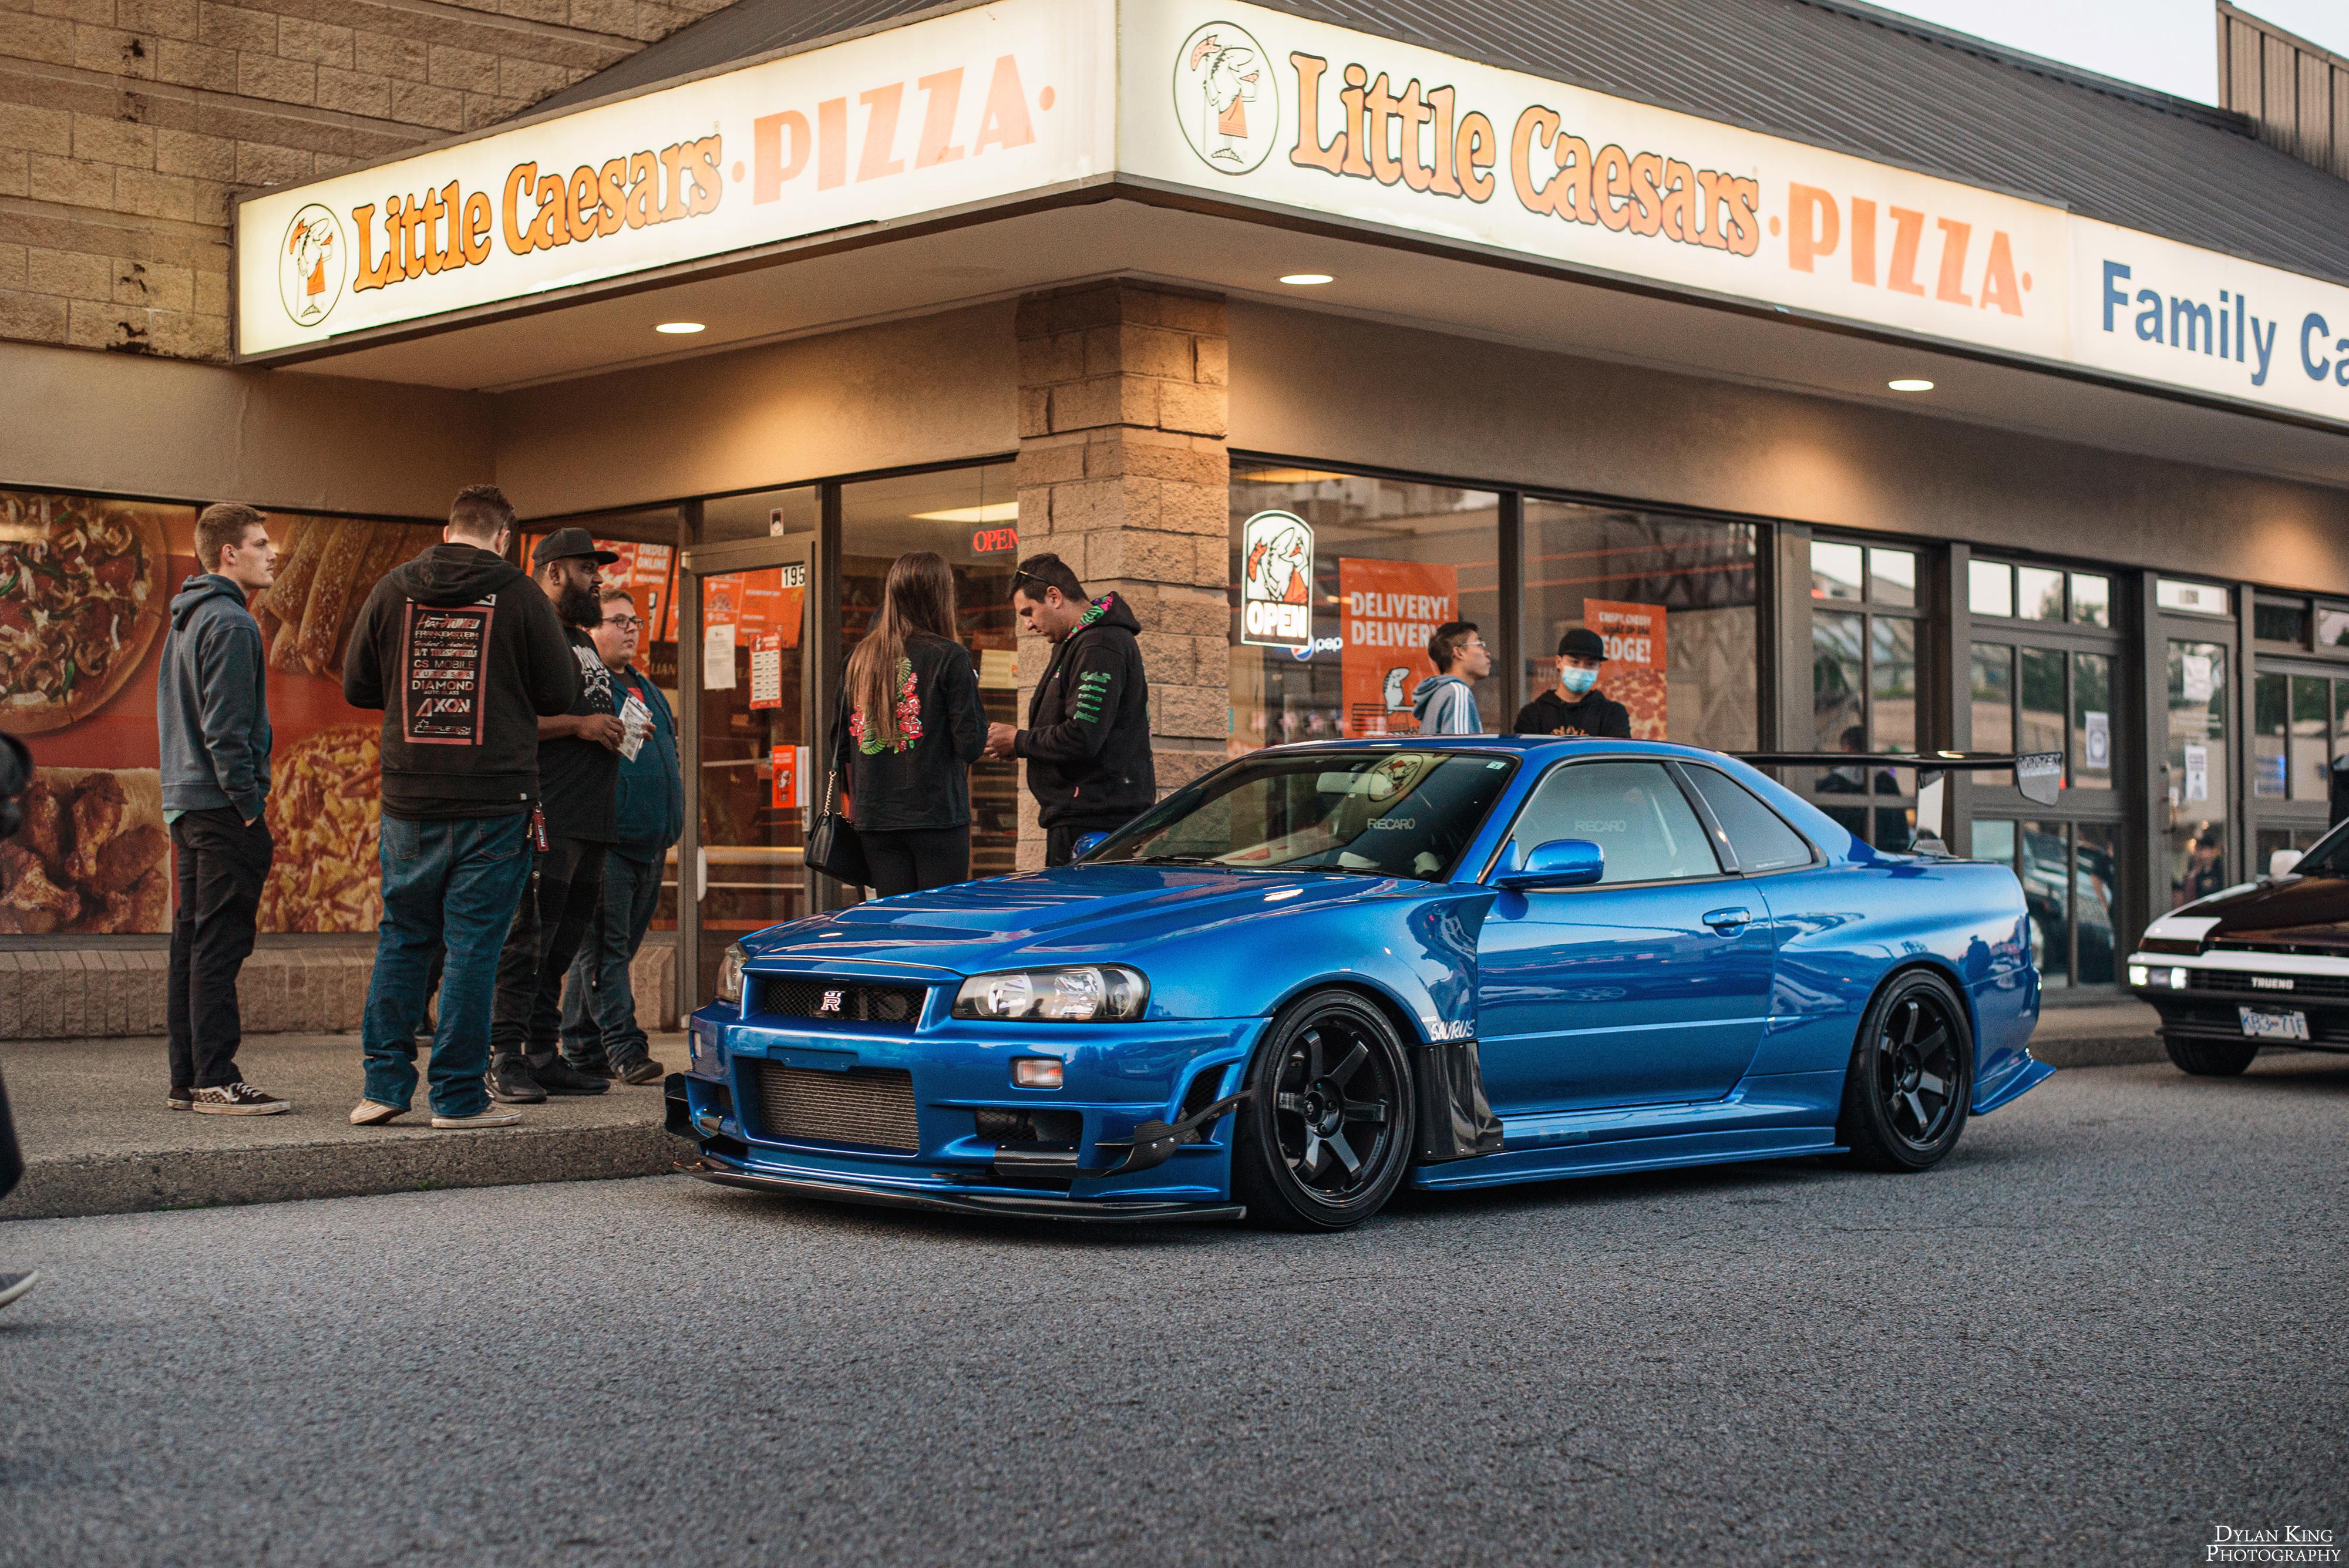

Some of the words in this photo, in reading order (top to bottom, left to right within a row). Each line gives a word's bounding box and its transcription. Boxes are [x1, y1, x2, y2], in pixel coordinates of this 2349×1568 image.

[1290, 51, 1496, 203] Little
[1511, 105, 1759, 257] Caesars
[352, 142, 492, 293] Little
[502, 133, 723, 255] Caesars
[2103, 259, 2277, 386] Family
[973, 528, 1019, 552] OPEN
[784, 566, 805, 586] 195
[1351, 591, 1449, 620] DELIVERY!
[1246, 601, 1307, 638] OPEN
[1600, 635, 1651, 664] EDGE!
[414, 659, 429, 668] CS
[435, 660, 475, 669] MOBILE
[412, 680, 474, 691] DIAMOND
[415, 698, 470, 716] AXON
[1367, 817, 1416, 830] RECARO
[1574, 820, 1627, 832] RECARO
[1431, 1019, 1475, 1041] SAURUS
